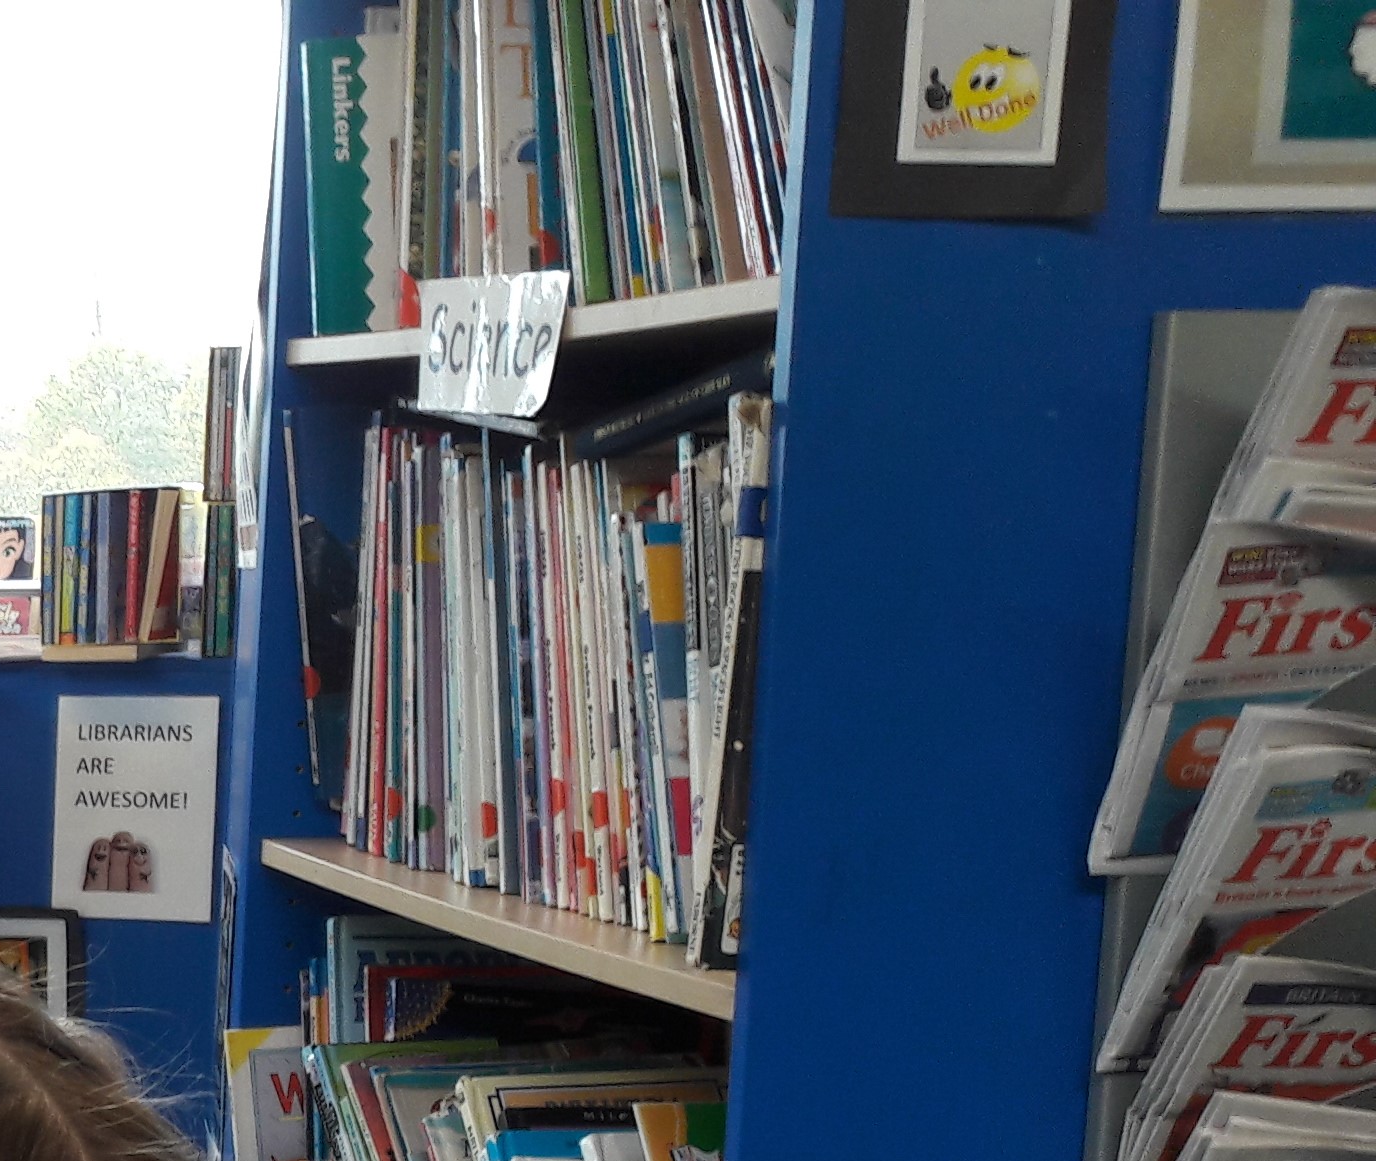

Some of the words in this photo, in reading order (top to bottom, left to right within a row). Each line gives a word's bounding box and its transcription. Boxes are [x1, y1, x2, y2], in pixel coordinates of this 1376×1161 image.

[331, 56, 352, 163] Linkers
[427, 301, 552, 378] Science
[78, 723, 193, 742] LIBRARIANS
[76, 758, 115, 775] ARE
[74, 791, 189, 810] AWESOME!
